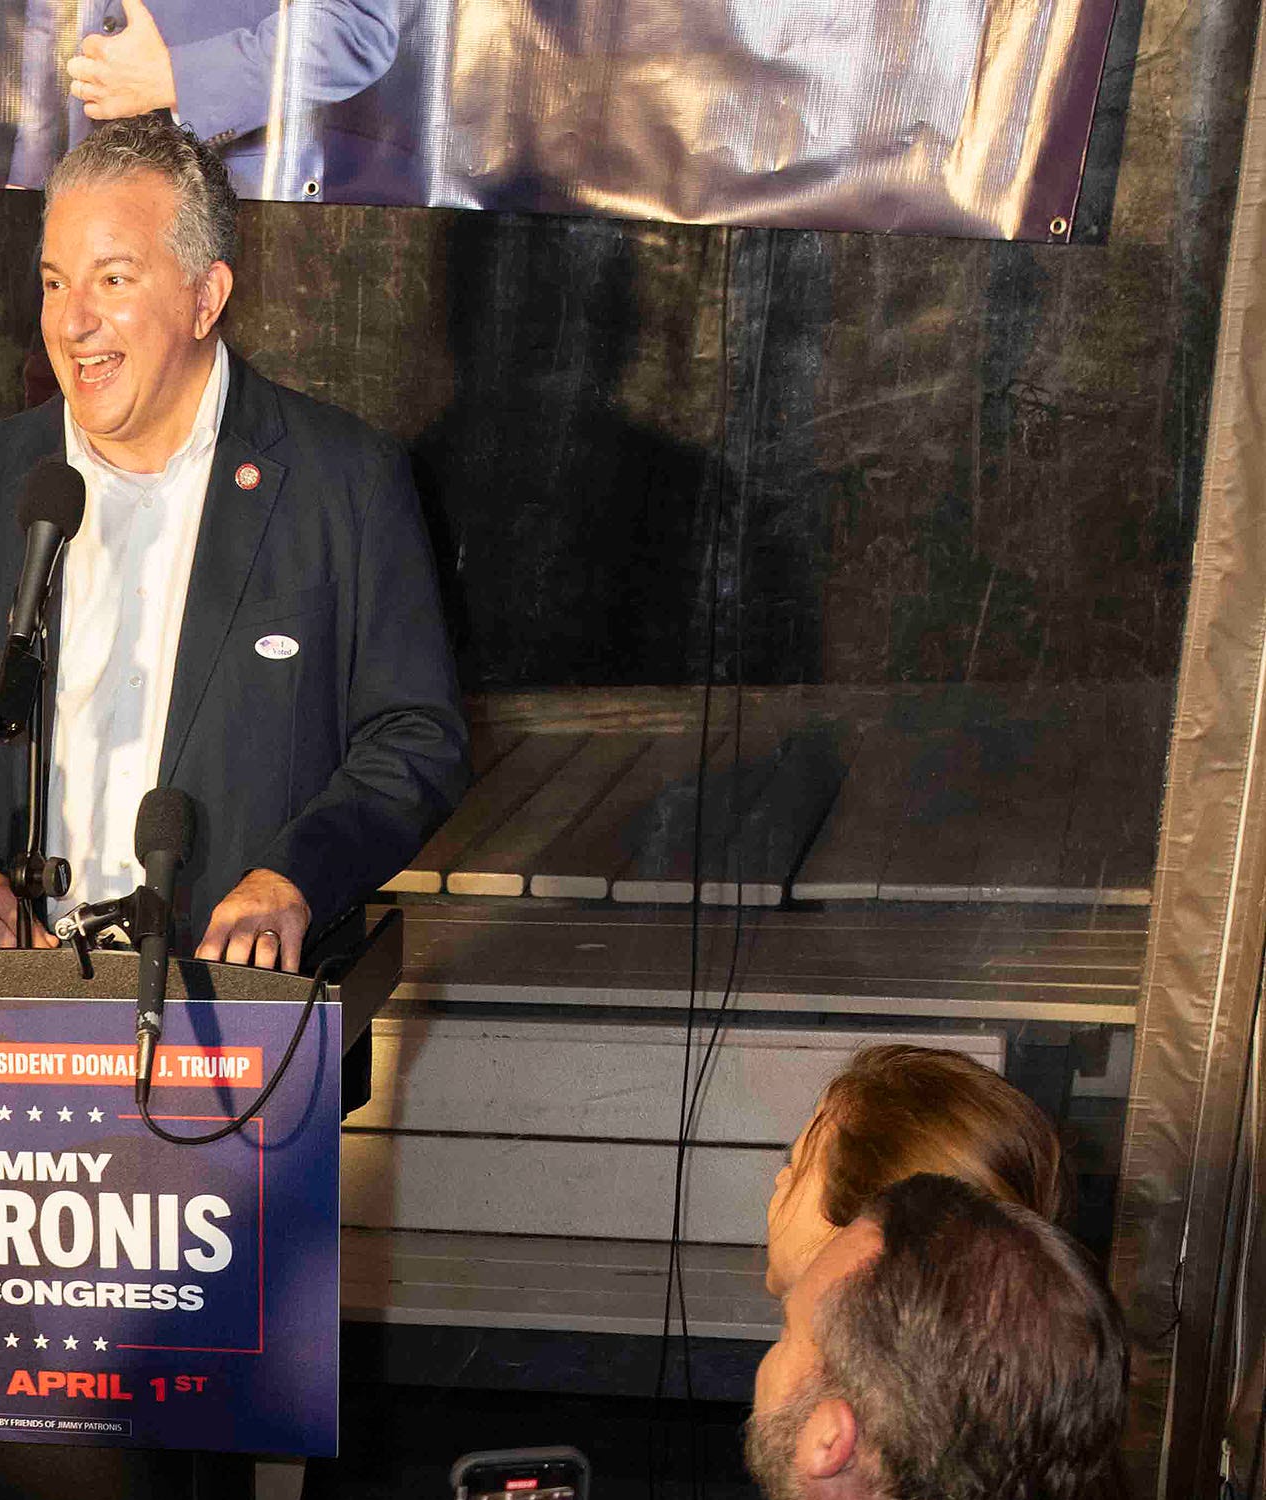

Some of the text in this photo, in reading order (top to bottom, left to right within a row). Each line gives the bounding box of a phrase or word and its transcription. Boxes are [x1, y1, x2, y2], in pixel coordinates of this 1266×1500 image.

[71, 1053, 140, 1077] DONAL
[157, 1055, 174, 1078] J.
[177, 1056, 251, 1080] TRUMP
[6, 1370, 134, 1400] APRIL
[0, 1418, 9, 1426] BY
[10, 1419, 44, 1428] FRIENDS
[44, 1420, 56, 1429] OF
[57, 1422, 83, 1430] JIMMY
[84, 1422, 123, 1431] PATRONIS
